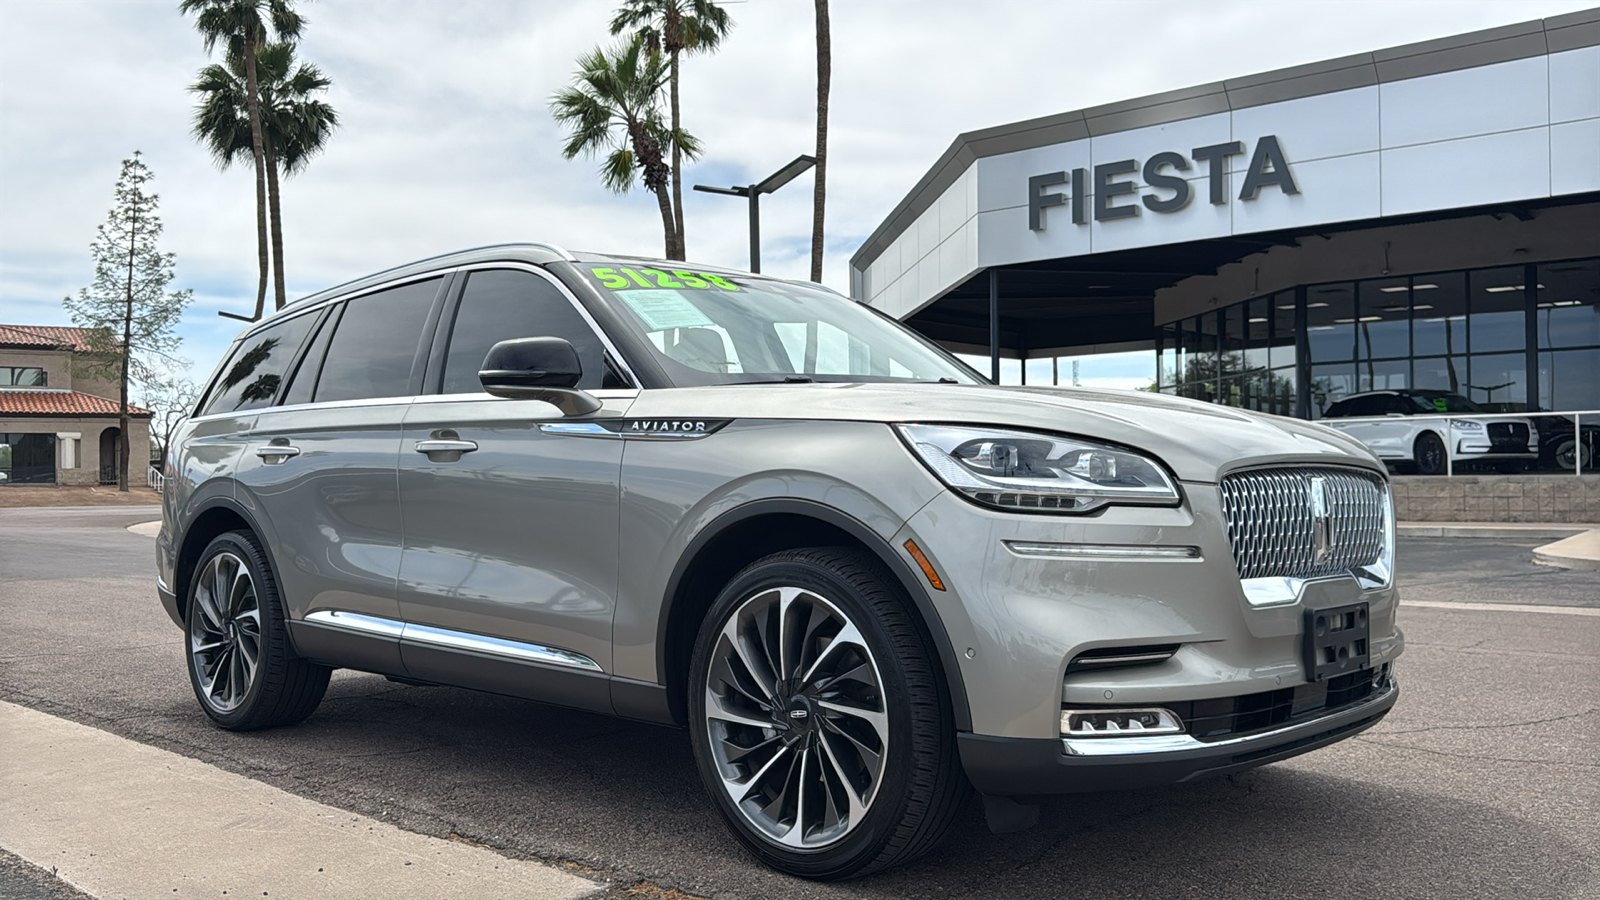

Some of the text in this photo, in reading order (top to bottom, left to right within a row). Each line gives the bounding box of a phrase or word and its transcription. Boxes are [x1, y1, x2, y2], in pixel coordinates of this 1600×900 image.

[1029, 135, 1300, 231] FIESTA
[591, 267, 740, 291] 51258
[631, 421, 706, 431] AVIATOR
